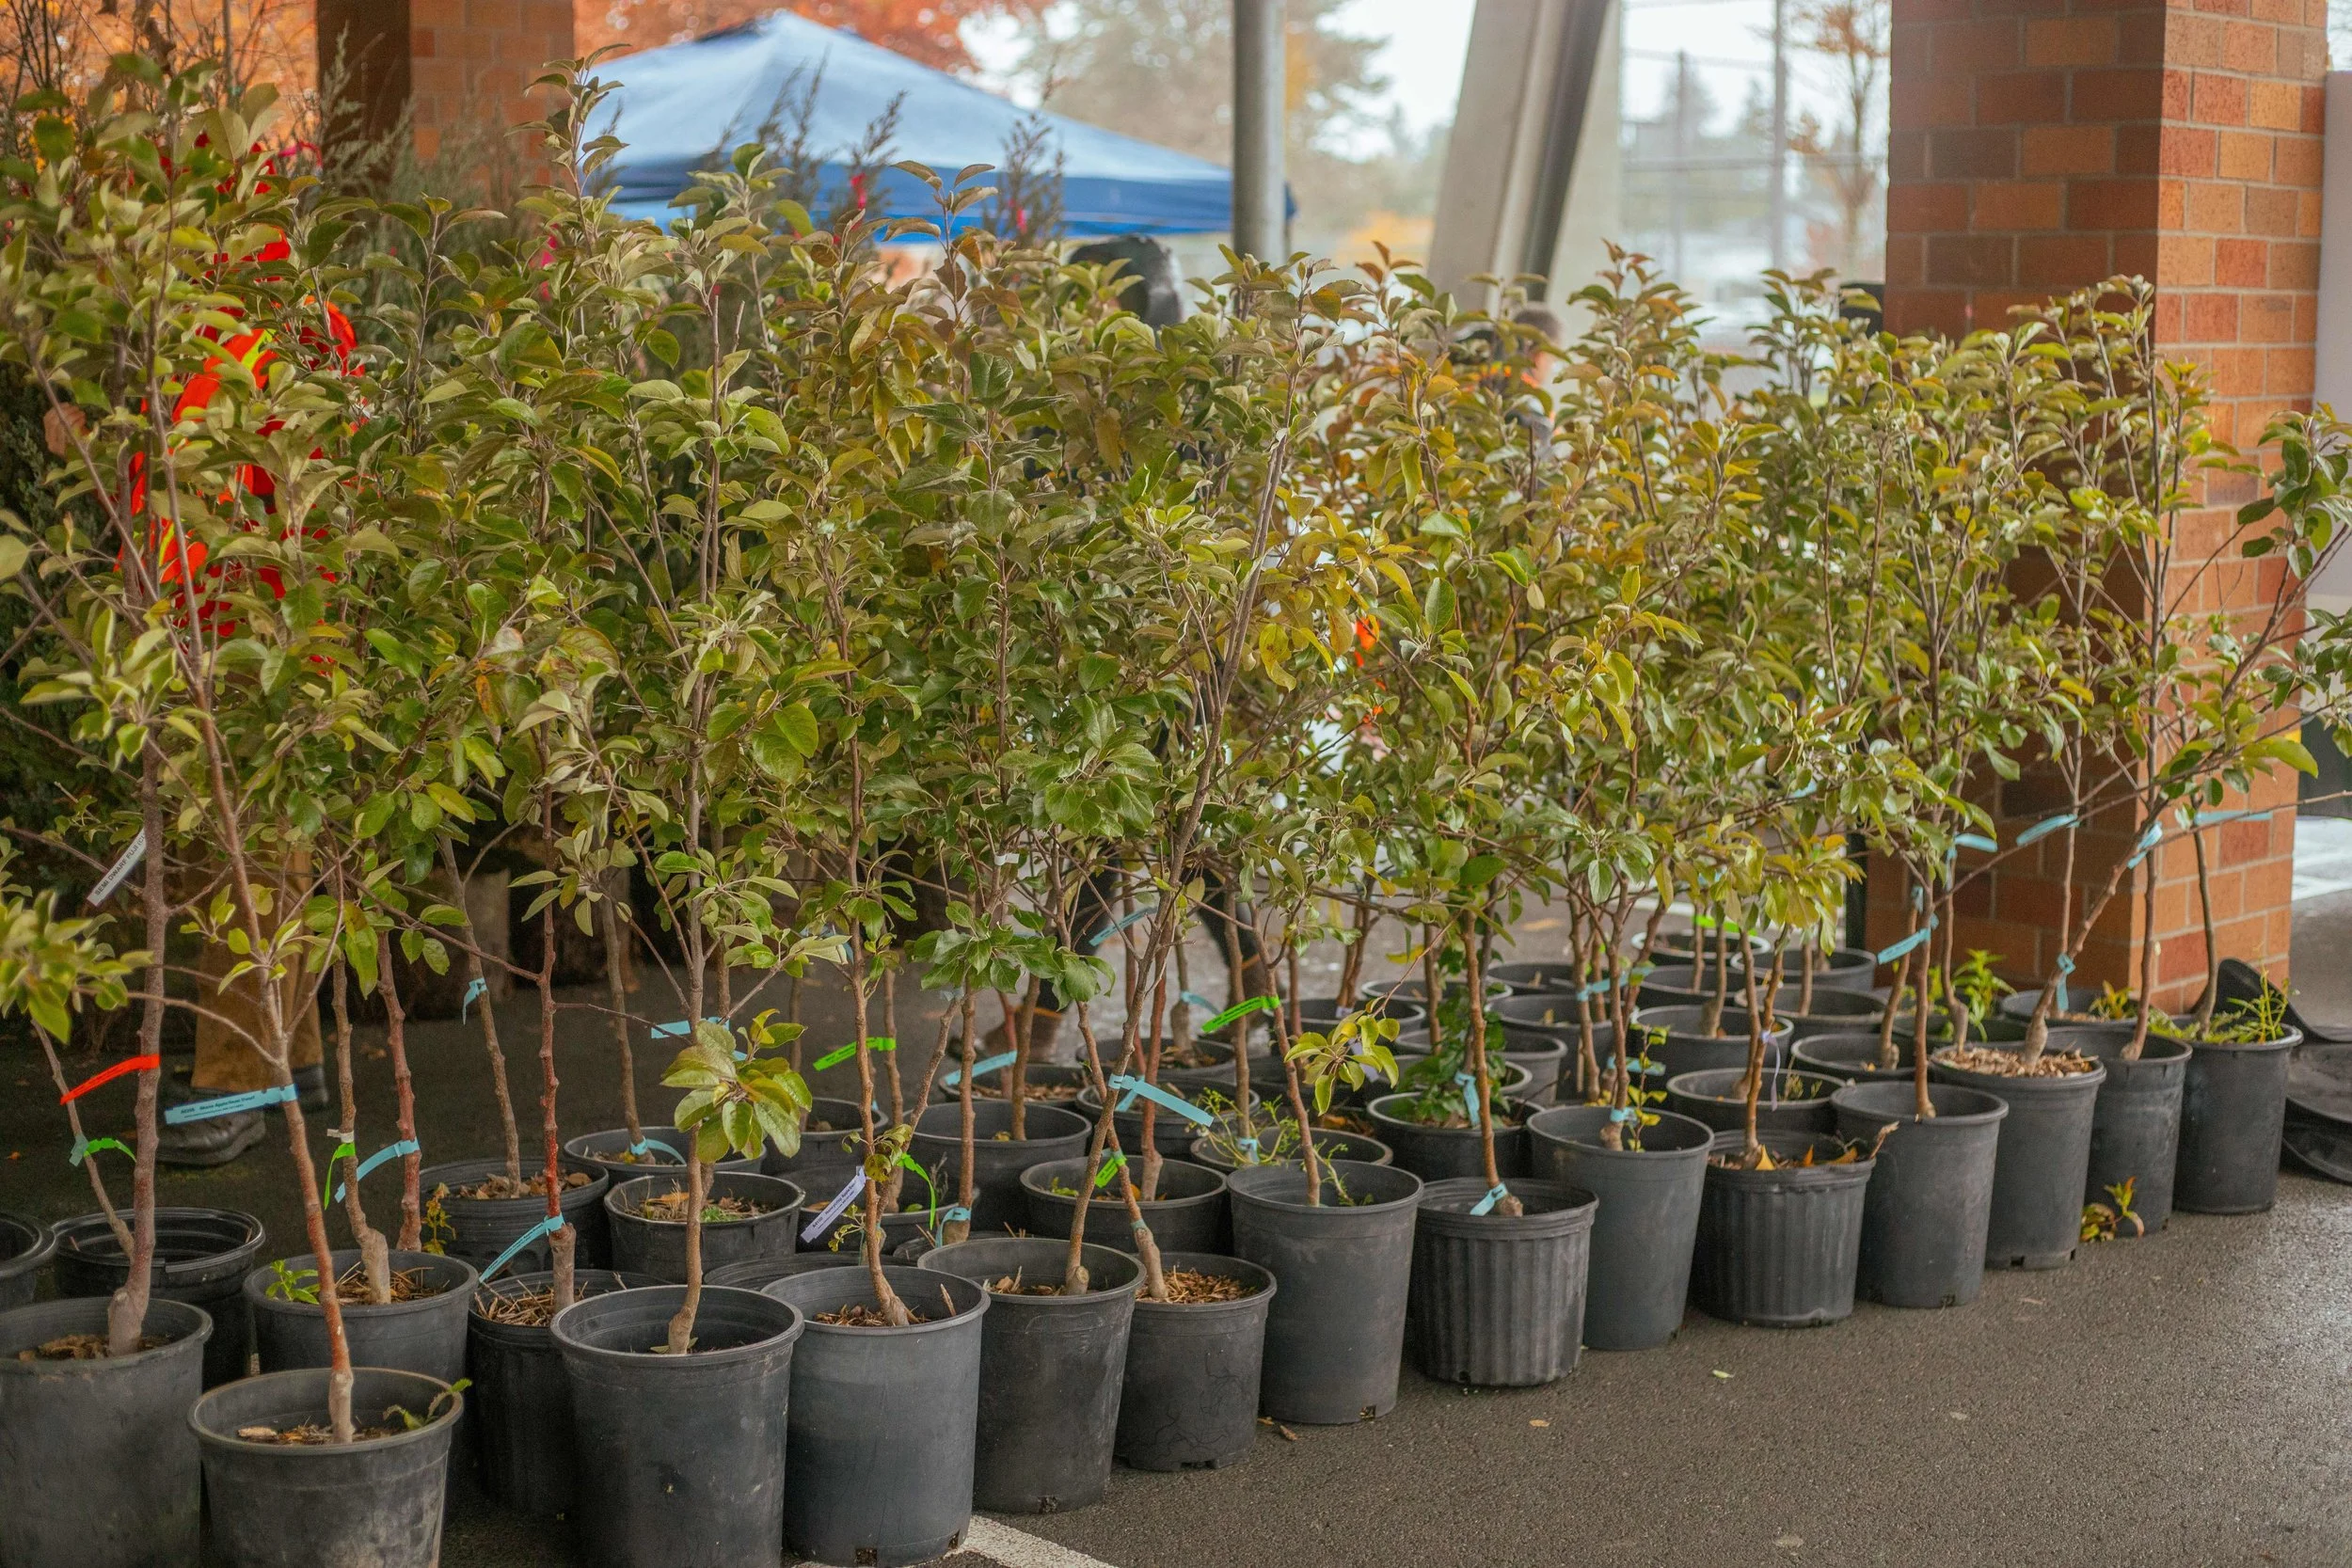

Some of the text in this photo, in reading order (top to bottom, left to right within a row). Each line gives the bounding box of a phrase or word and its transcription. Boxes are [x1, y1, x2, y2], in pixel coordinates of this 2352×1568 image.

[94, 879, 109, 895] SEMI
[107, 858, 128, 881] DWARF
[126, 844, 139, 860] FUJI
